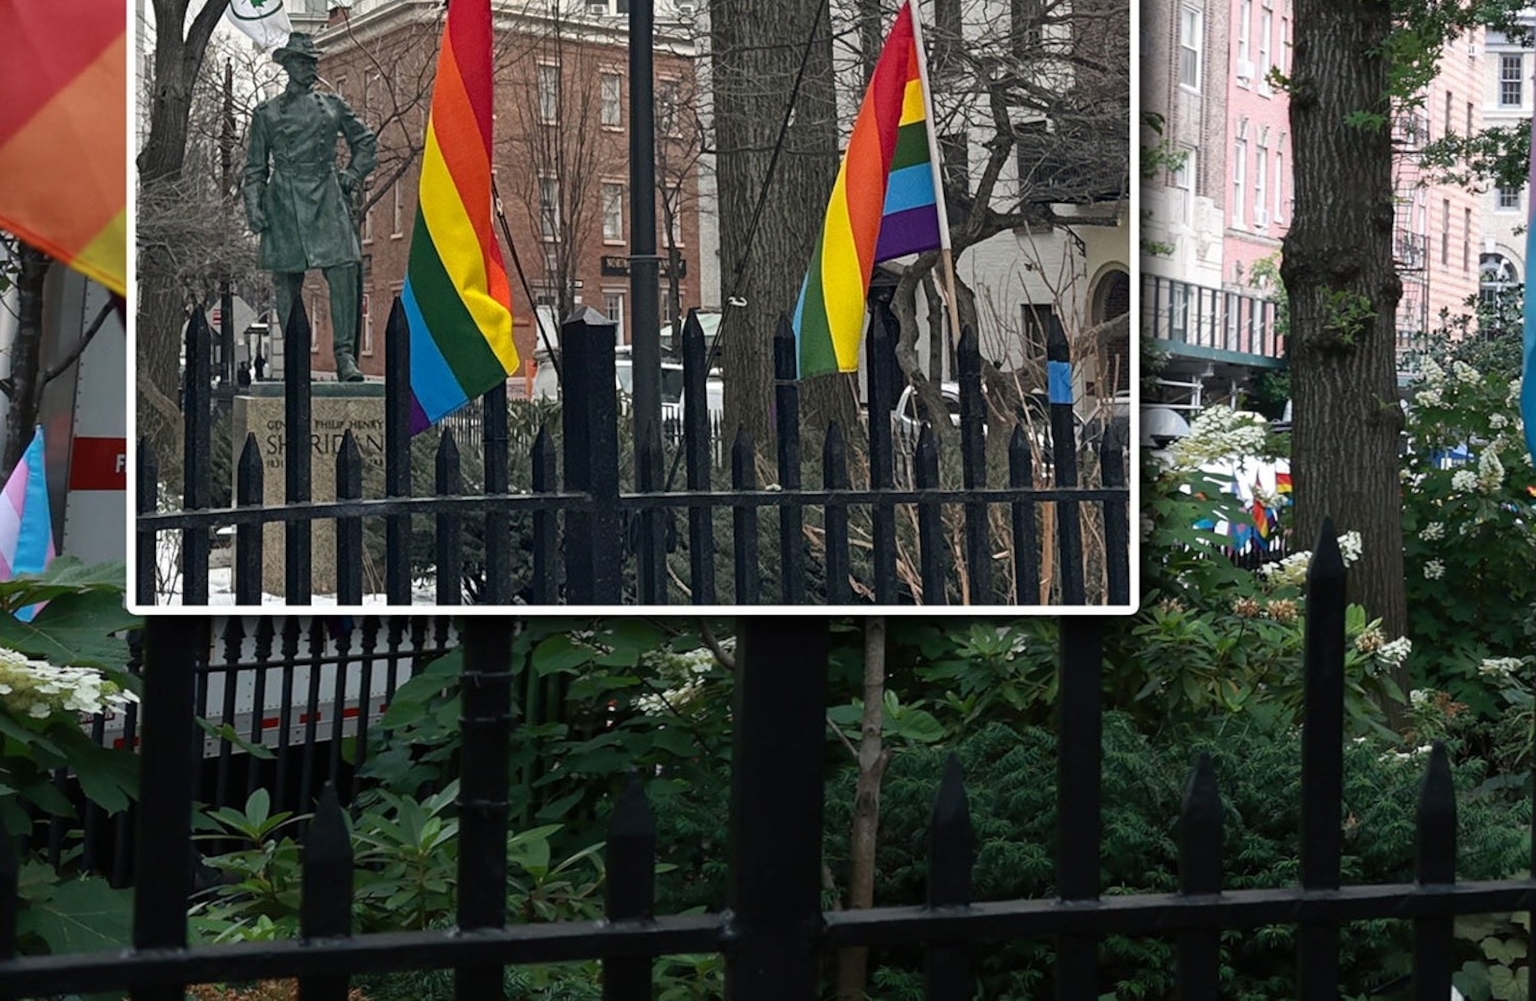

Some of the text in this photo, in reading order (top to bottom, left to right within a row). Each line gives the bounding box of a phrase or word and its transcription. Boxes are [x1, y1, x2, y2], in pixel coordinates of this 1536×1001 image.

[266, 420, 286, 431] GEN
[350, 420, 384, 430] HENRY
[115, 453, 126, 473] F
